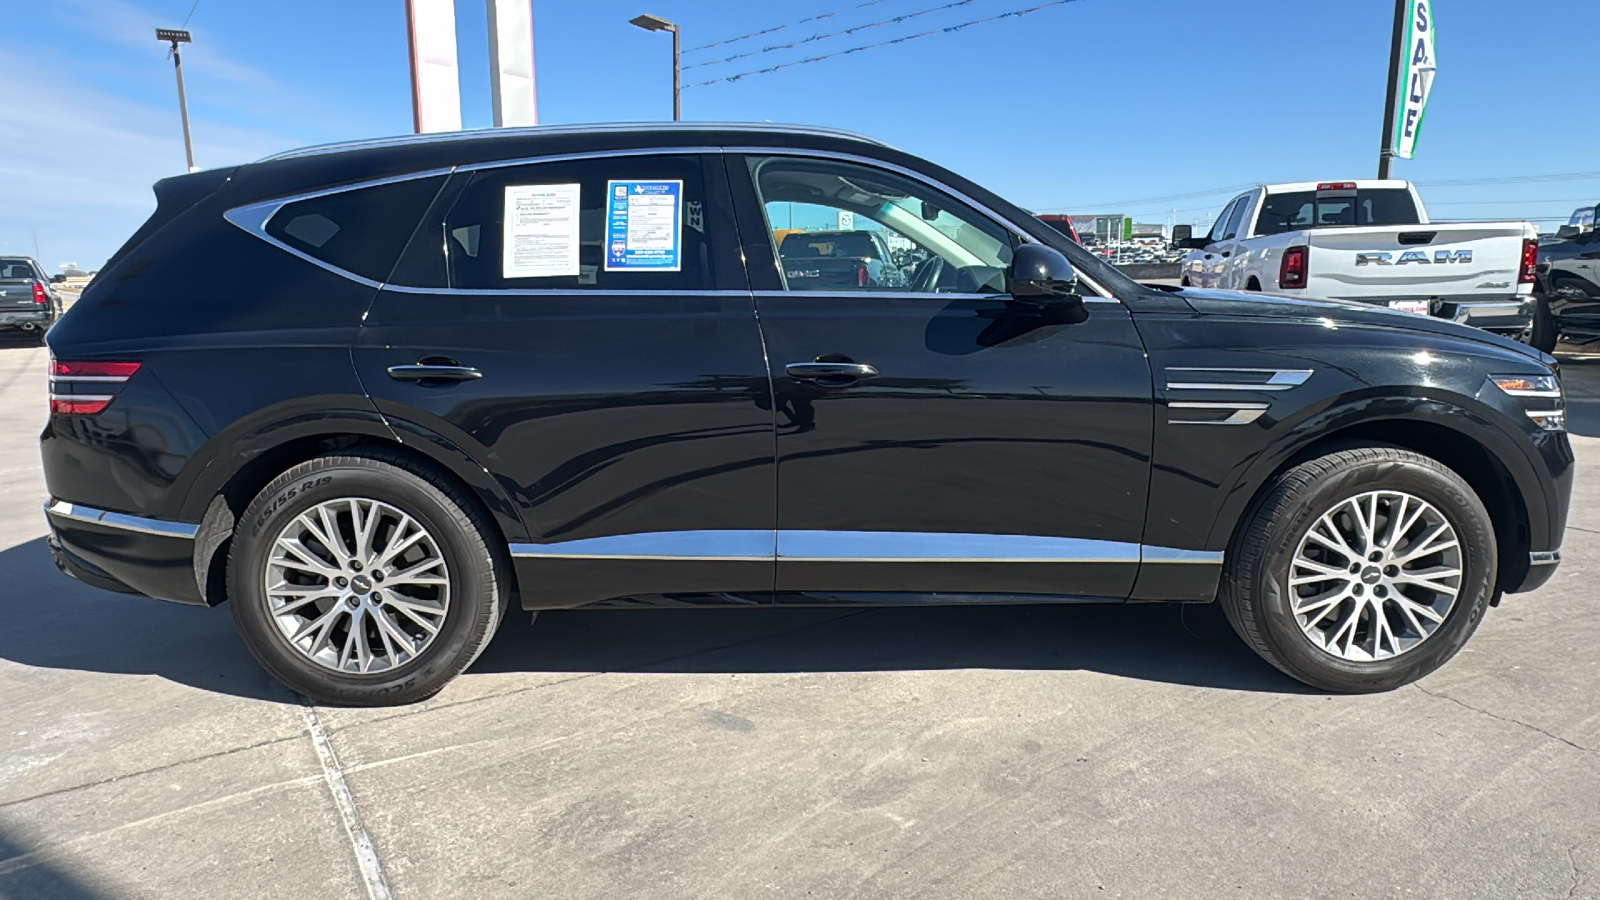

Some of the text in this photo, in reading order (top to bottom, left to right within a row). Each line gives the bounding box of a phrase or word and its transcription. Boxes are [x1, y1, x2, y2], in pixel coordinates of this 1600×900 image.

[1404, 2, 1428, 137] SALE
[1355, 249, 1473, 266] RAM
[301, 476, 333, 492] R19
